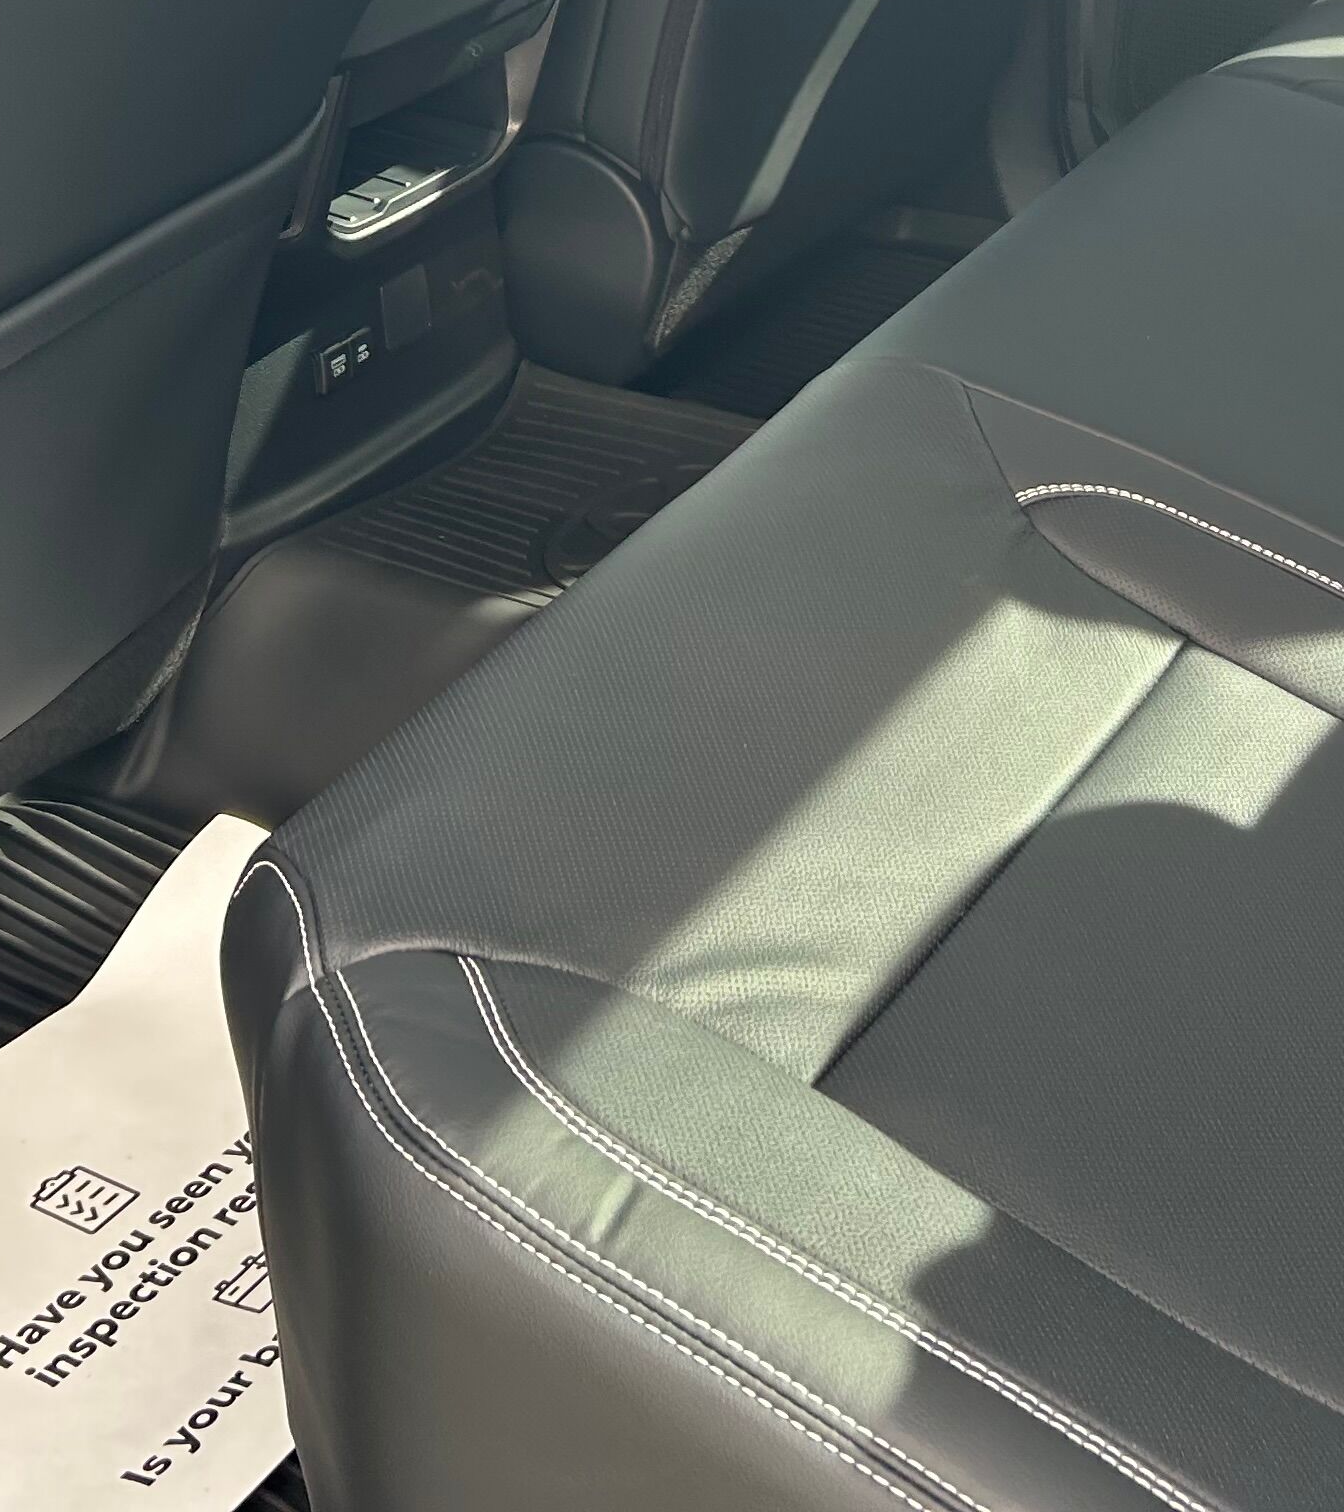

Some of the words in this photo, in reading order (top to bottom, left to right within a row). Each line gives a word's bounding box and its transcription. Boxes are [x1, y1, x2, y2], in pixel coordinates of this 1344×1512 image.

[78, 1229, 155, 1293] you
[149, 1162, 233, 1229] seen
[24, 1226, 223, 1388] inspection
[120, 1454, 172, 1486] Is
[164, 1370, 253, 1454] your
